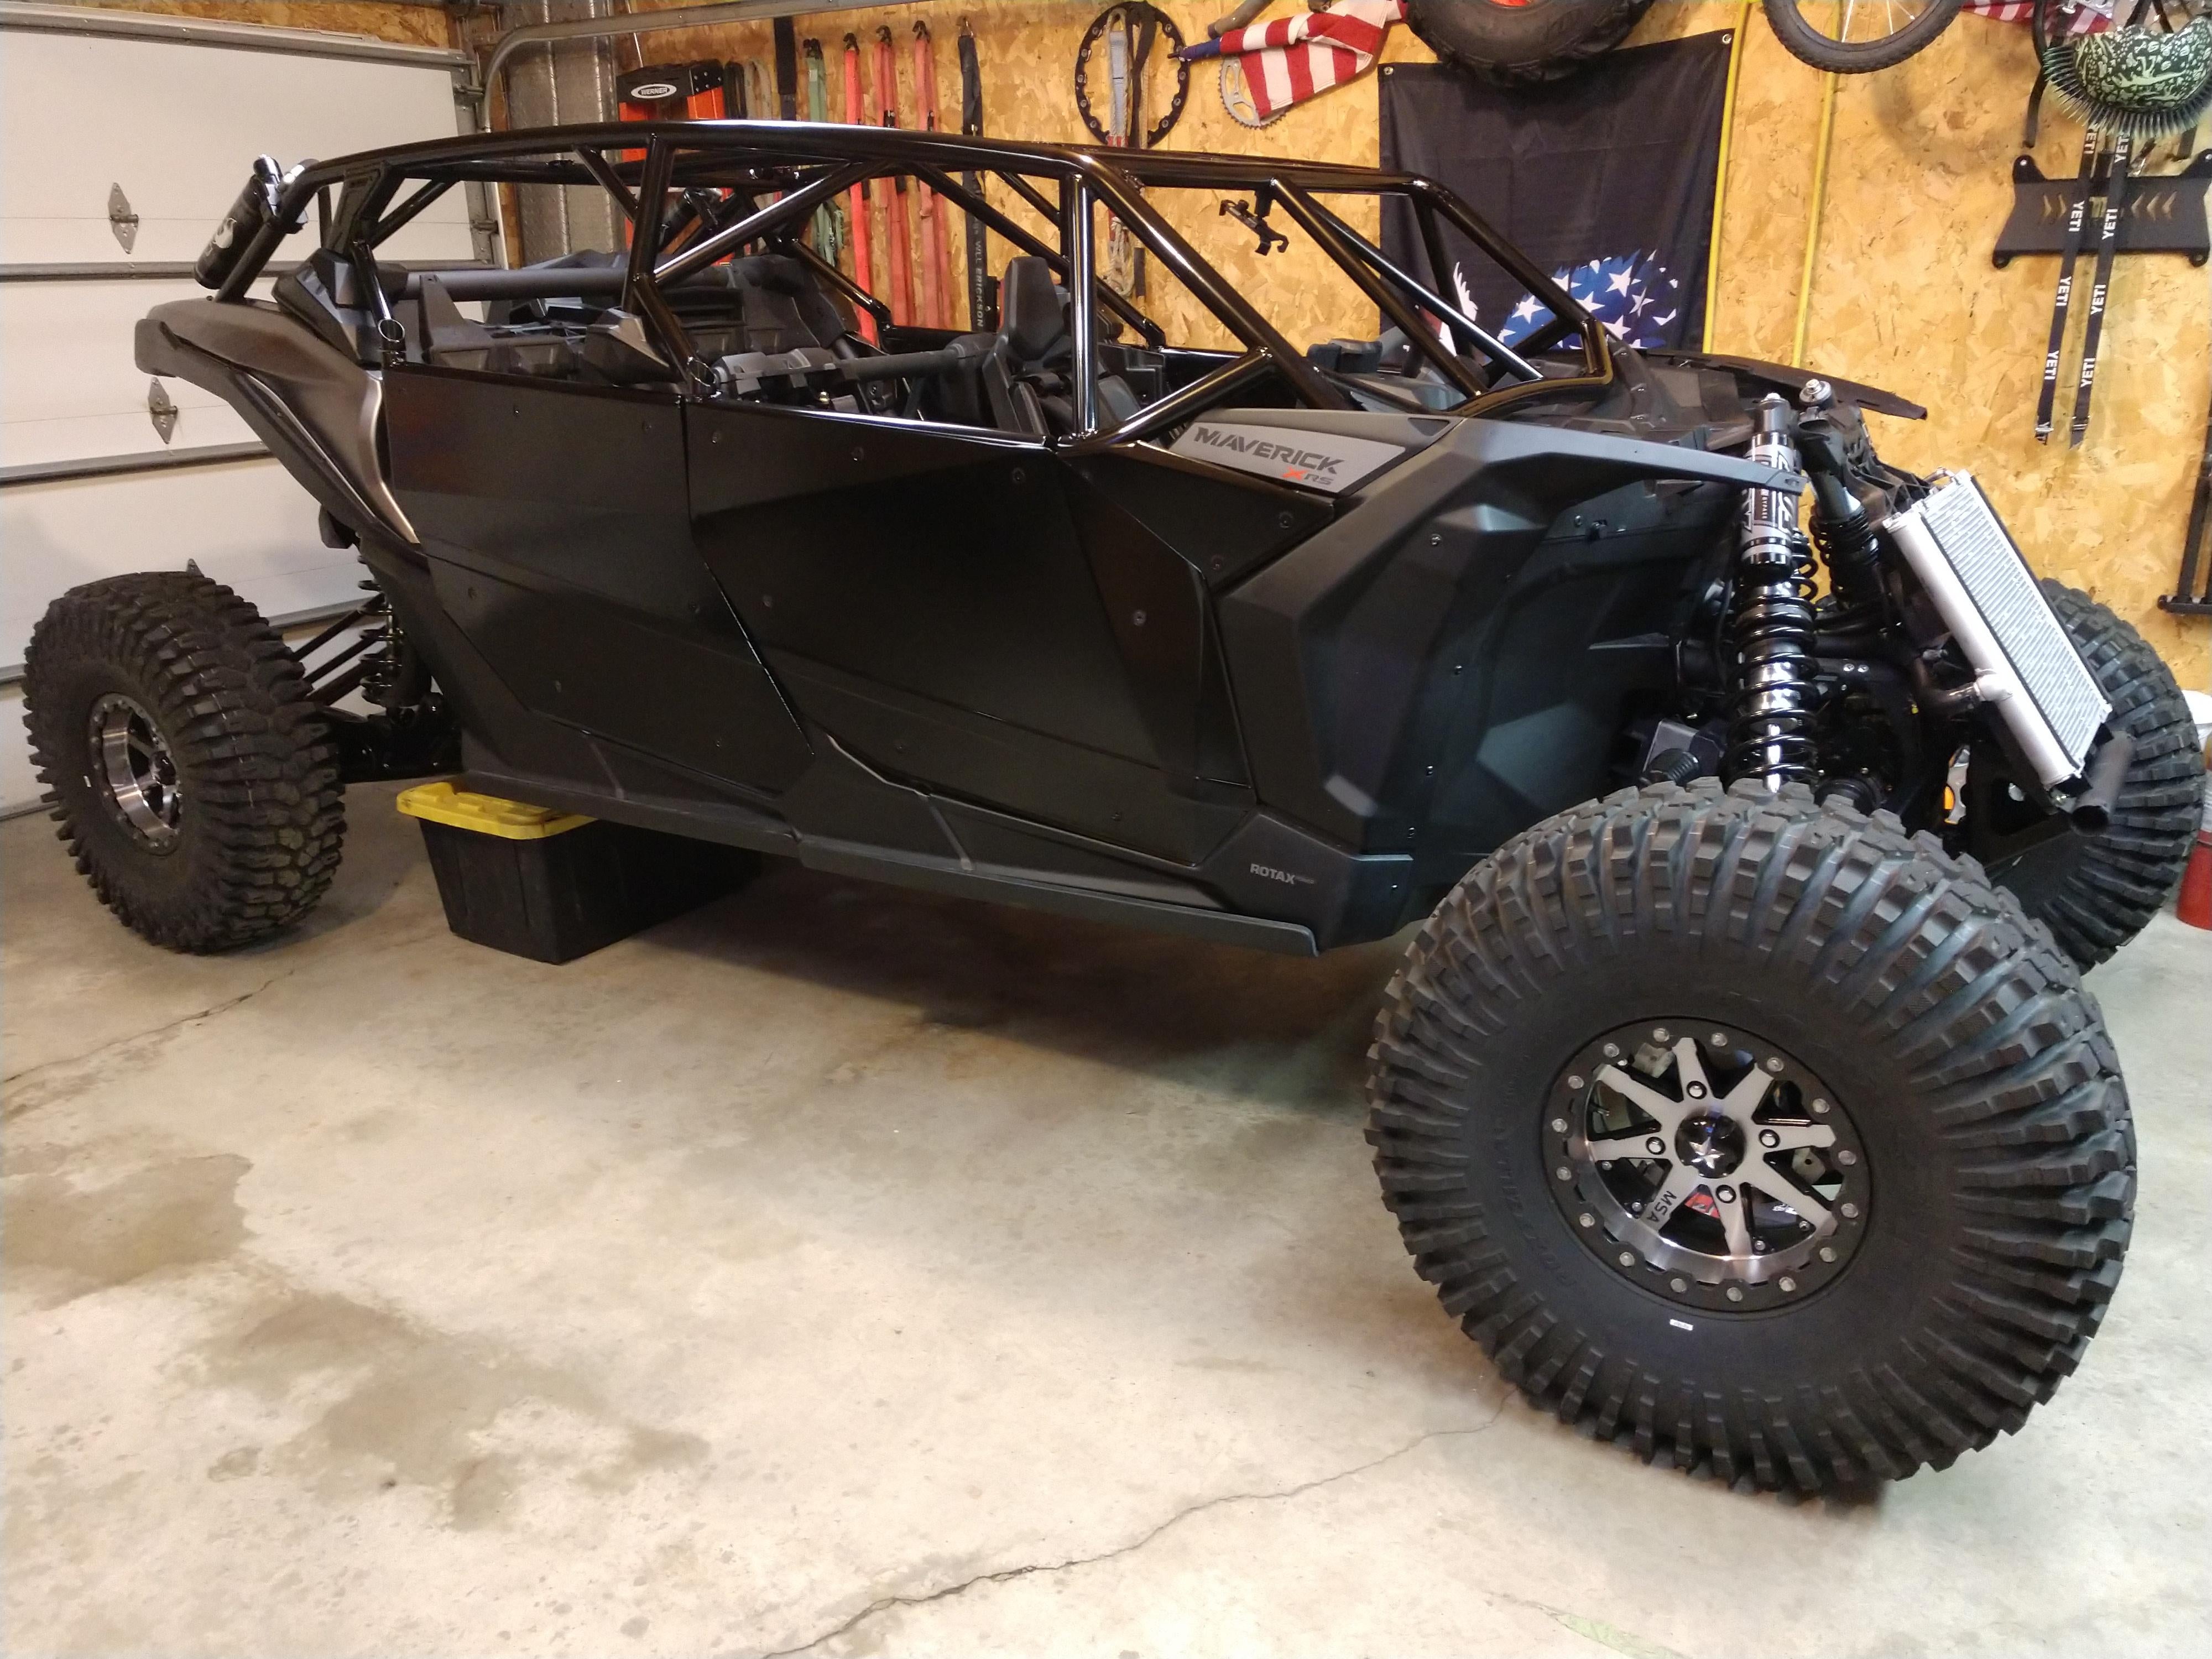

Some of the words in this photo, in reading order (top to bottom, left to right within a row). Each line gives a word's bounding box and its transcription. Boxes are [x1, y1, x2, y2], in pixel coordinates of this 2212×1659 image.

[641, 87, 667, 95] WERNER
[2083, 132, 2098, 155] ETI
[2114, 135, 2130, 163] YET
[2068, 200, 2085, 232] YETI
[2102, 208, 2119, 240] YETI
[975, 268, 984, 327] ERICKSON
[2056, 276, 2072, 306] YETI
[2090, 284, 2106, 315] YETI
[2044, 350, 2060, 380] YETI
[2080, 358, 2096, 388] YETI
[1193, 426, 1345, 474] MAVERICK
[1249, 863, 1295, 885] ROTAX
[1646, 1190, 1677, 1223] MSA
